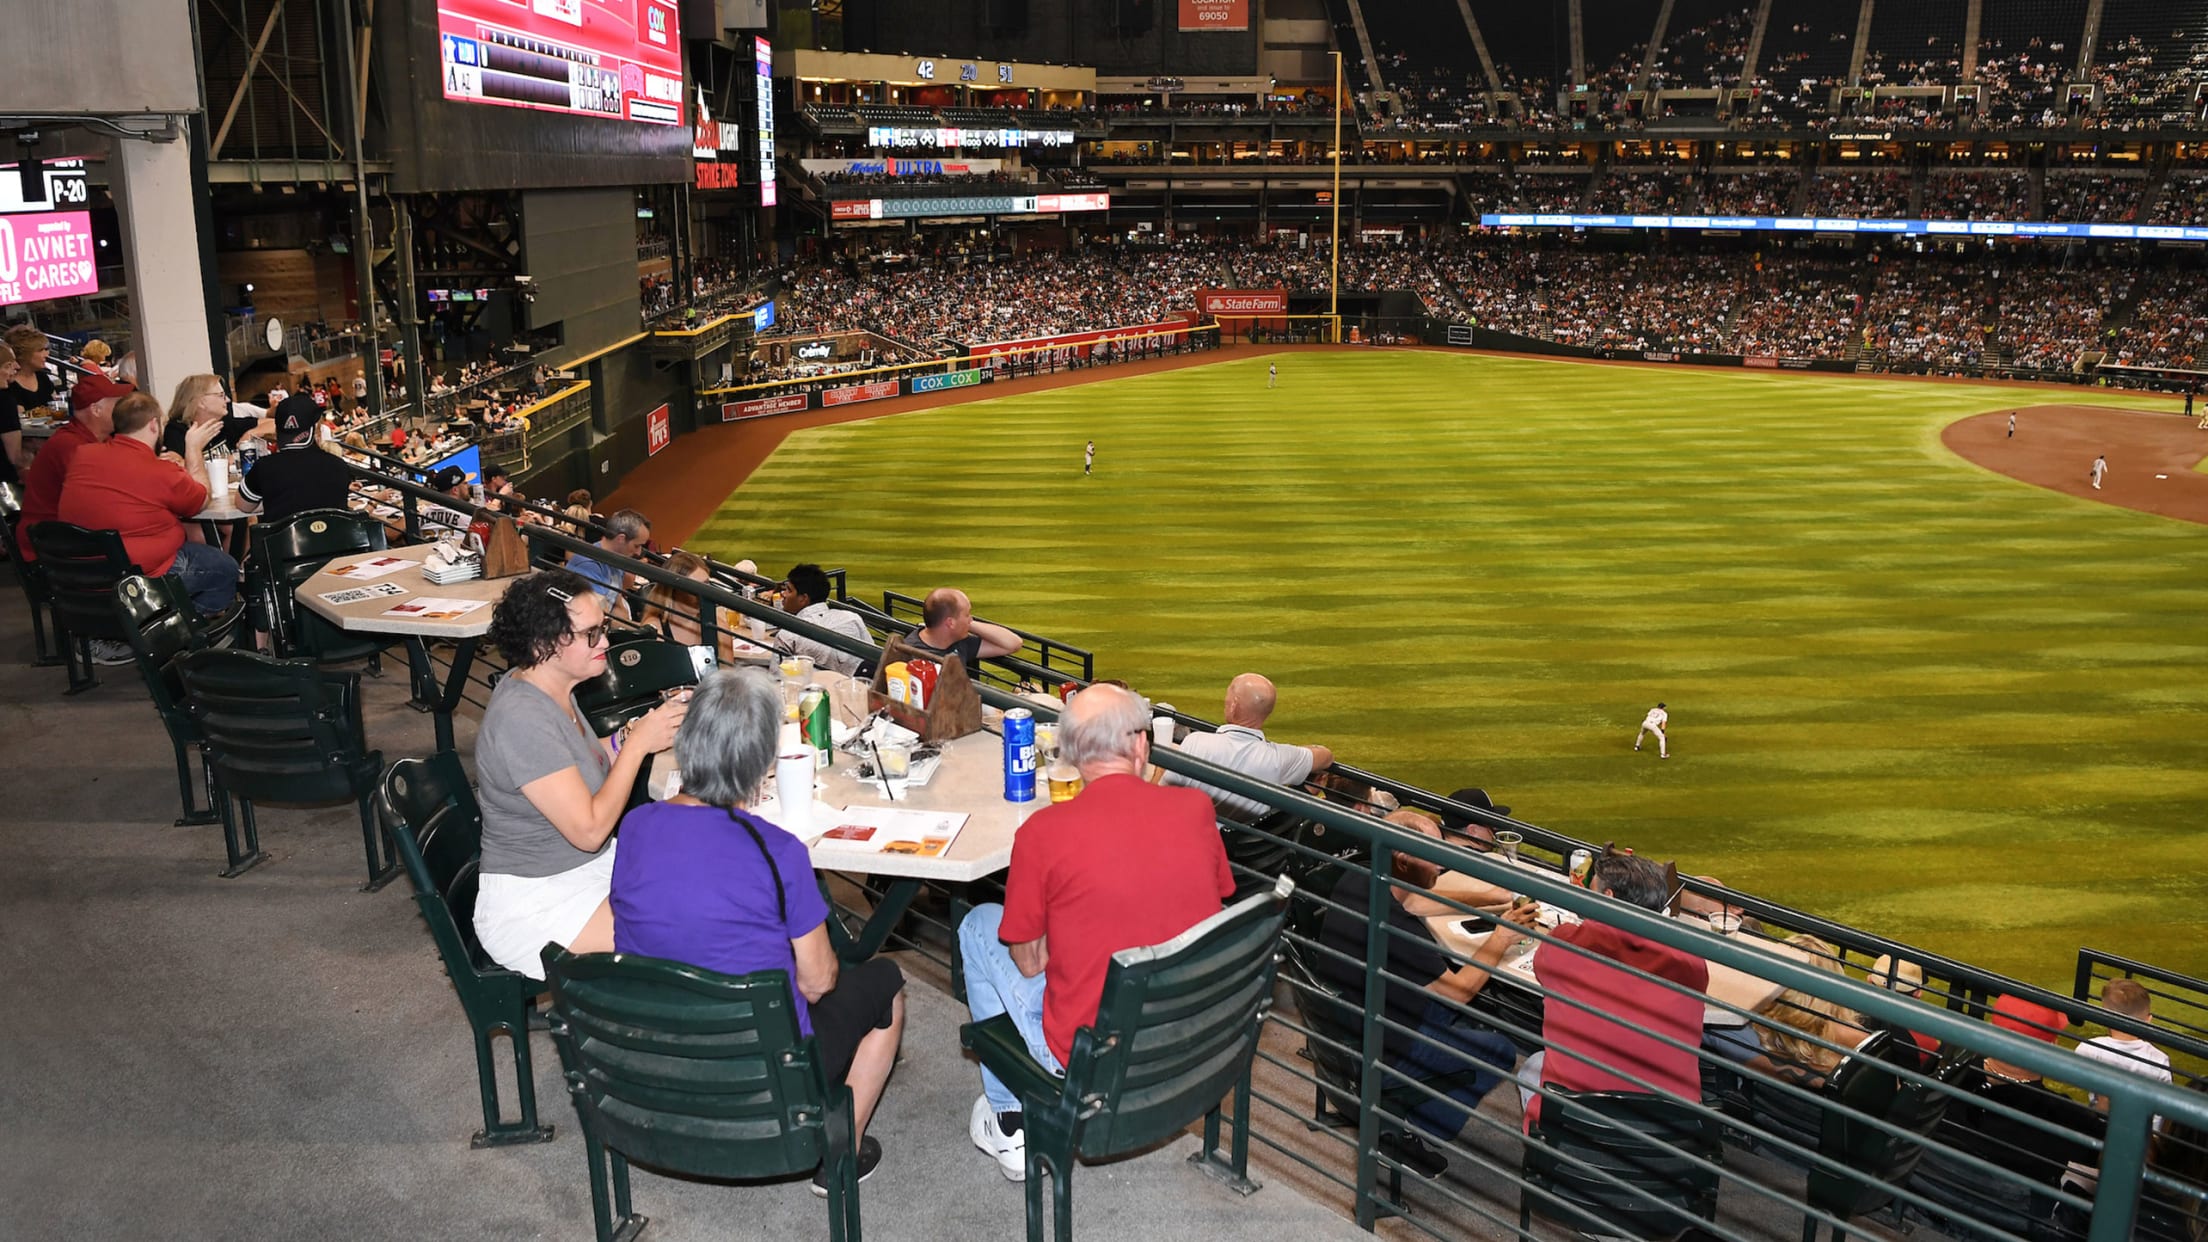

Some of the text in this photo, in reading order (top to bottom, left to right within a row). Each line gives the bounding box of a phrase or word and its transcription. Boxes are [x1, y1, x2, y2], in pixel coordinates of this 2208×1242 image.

[648, 6, 665, 33] COX
[1199, 11, 1228, 21] 69050
[917, 60, 1013, 83] 42 20 51
[719, 122, 739, 151] LIGHT
[697, 163, 738, 190] STRIKE ZONE
[896, 160, 944, 176] ULTRA
[53, 179, 87, 203] P-20
[24, 233, 89, 262] AVNET
[25, 262, 80, 290] CARES
[920, 373, 973, 390] COX COX
[981, 370, 993, 379] 374
[743, 401, 777, 413] ADVANTAGE
[778, 399, 802, 408] MEMBER
[984, 1119, 993, 1137] N
